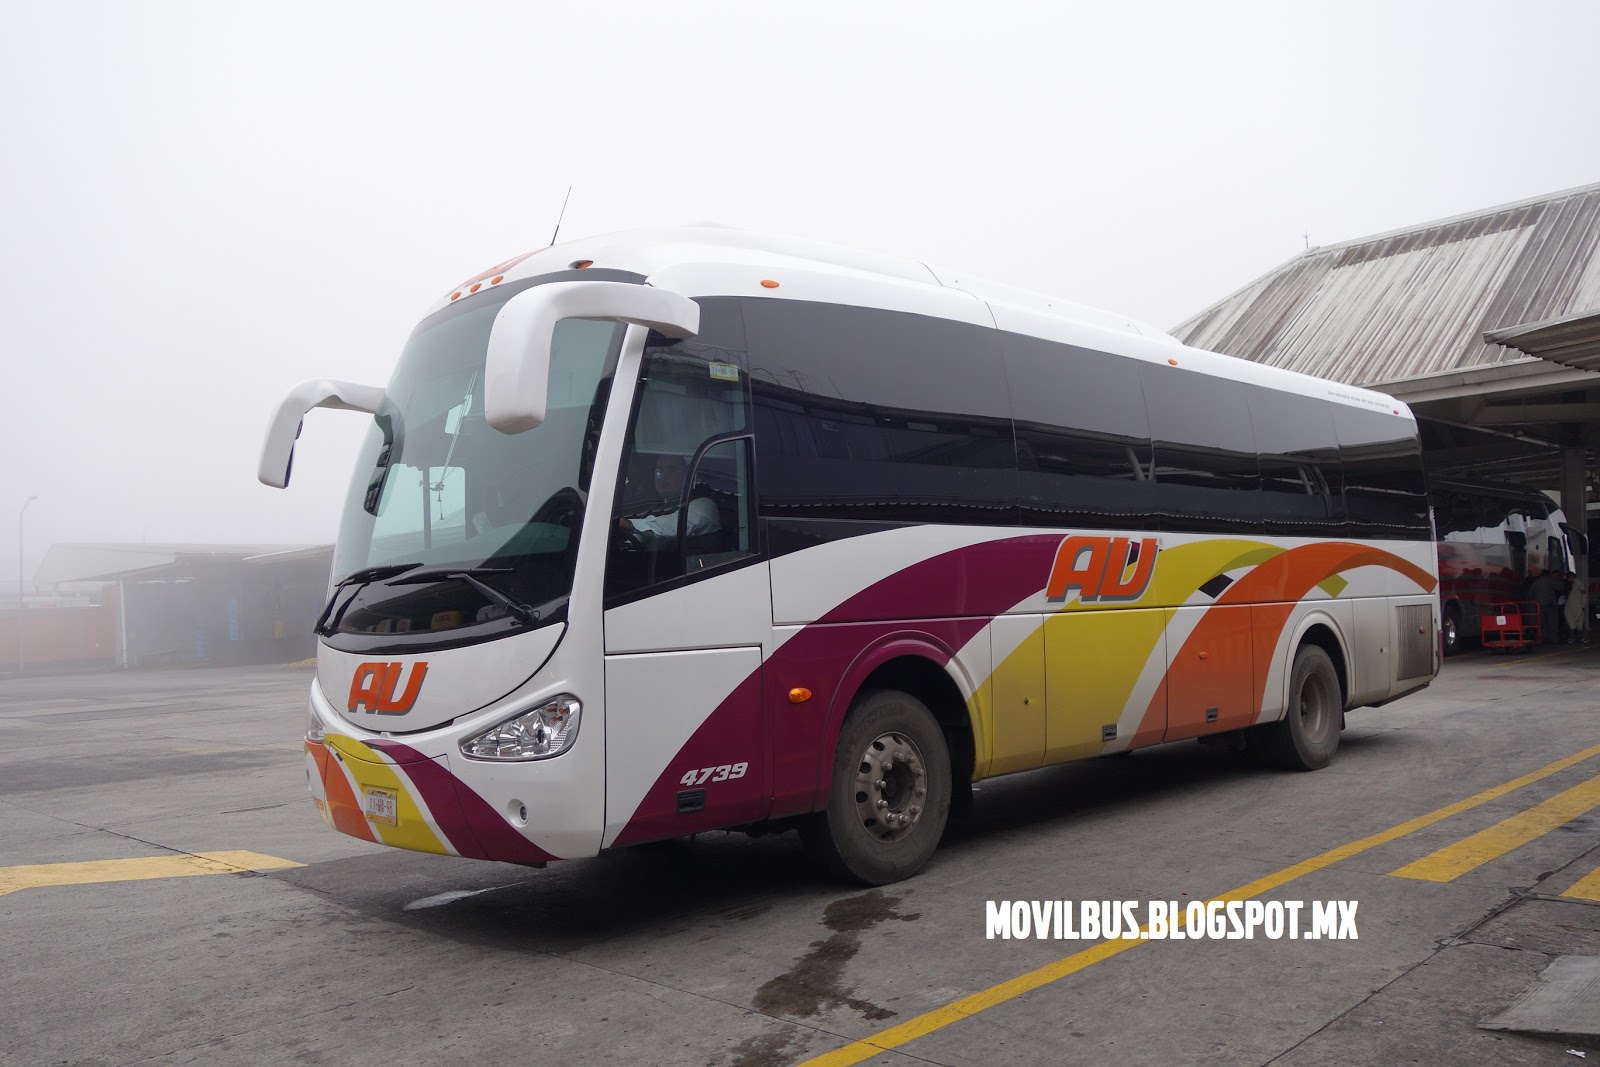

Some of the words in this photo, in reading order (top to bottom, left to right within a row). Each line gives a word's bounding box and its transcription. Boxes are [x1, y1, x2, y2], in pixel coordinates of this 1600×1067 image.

[1045, 535, 1159, 603] AU
[347, 661, 429, 716] AU
[679, 762, 749, 786] 4739
